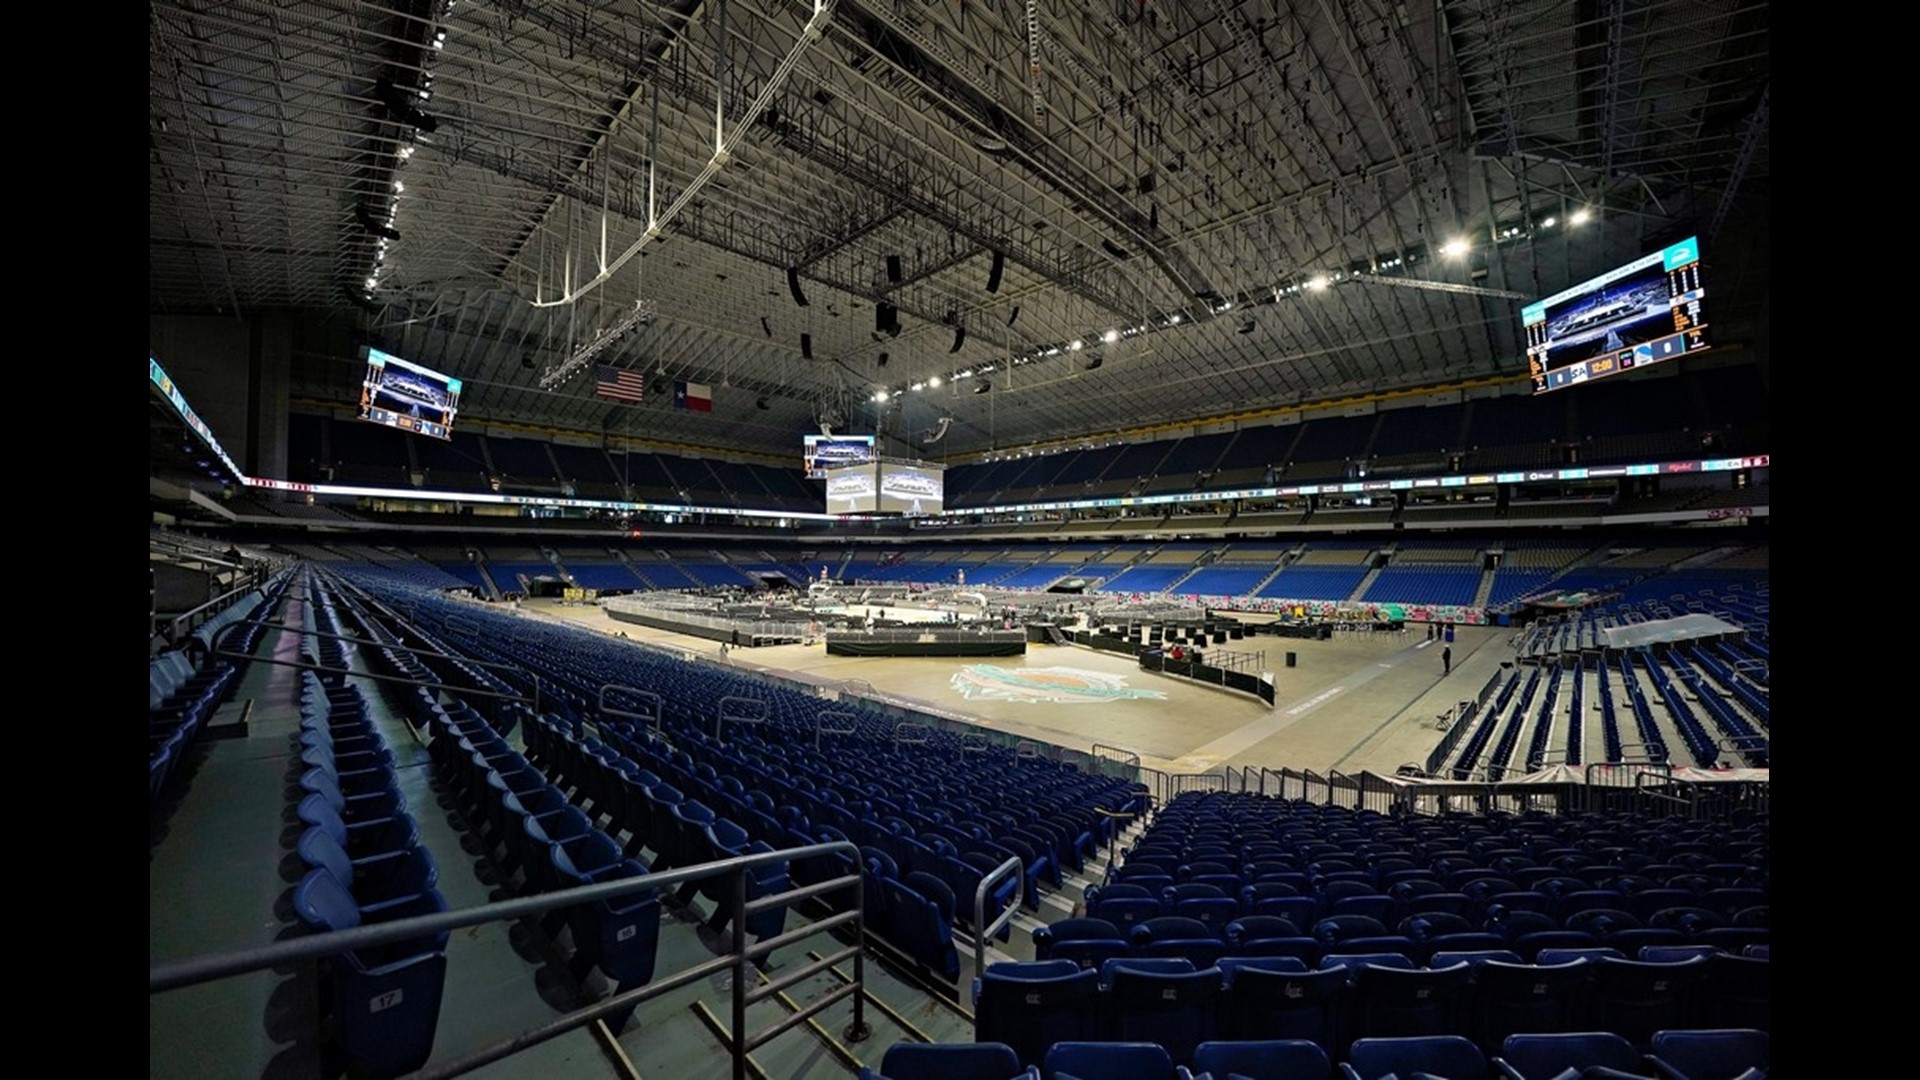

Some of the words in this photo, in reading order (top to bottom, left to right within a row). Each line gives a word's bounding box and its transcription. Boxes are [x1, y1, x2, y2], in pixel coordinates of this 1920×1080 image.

[1591, 359, 1613, 372] 12:00
[621, 927, 633, 940] 16
[377, 993, 396, 1008] 17
